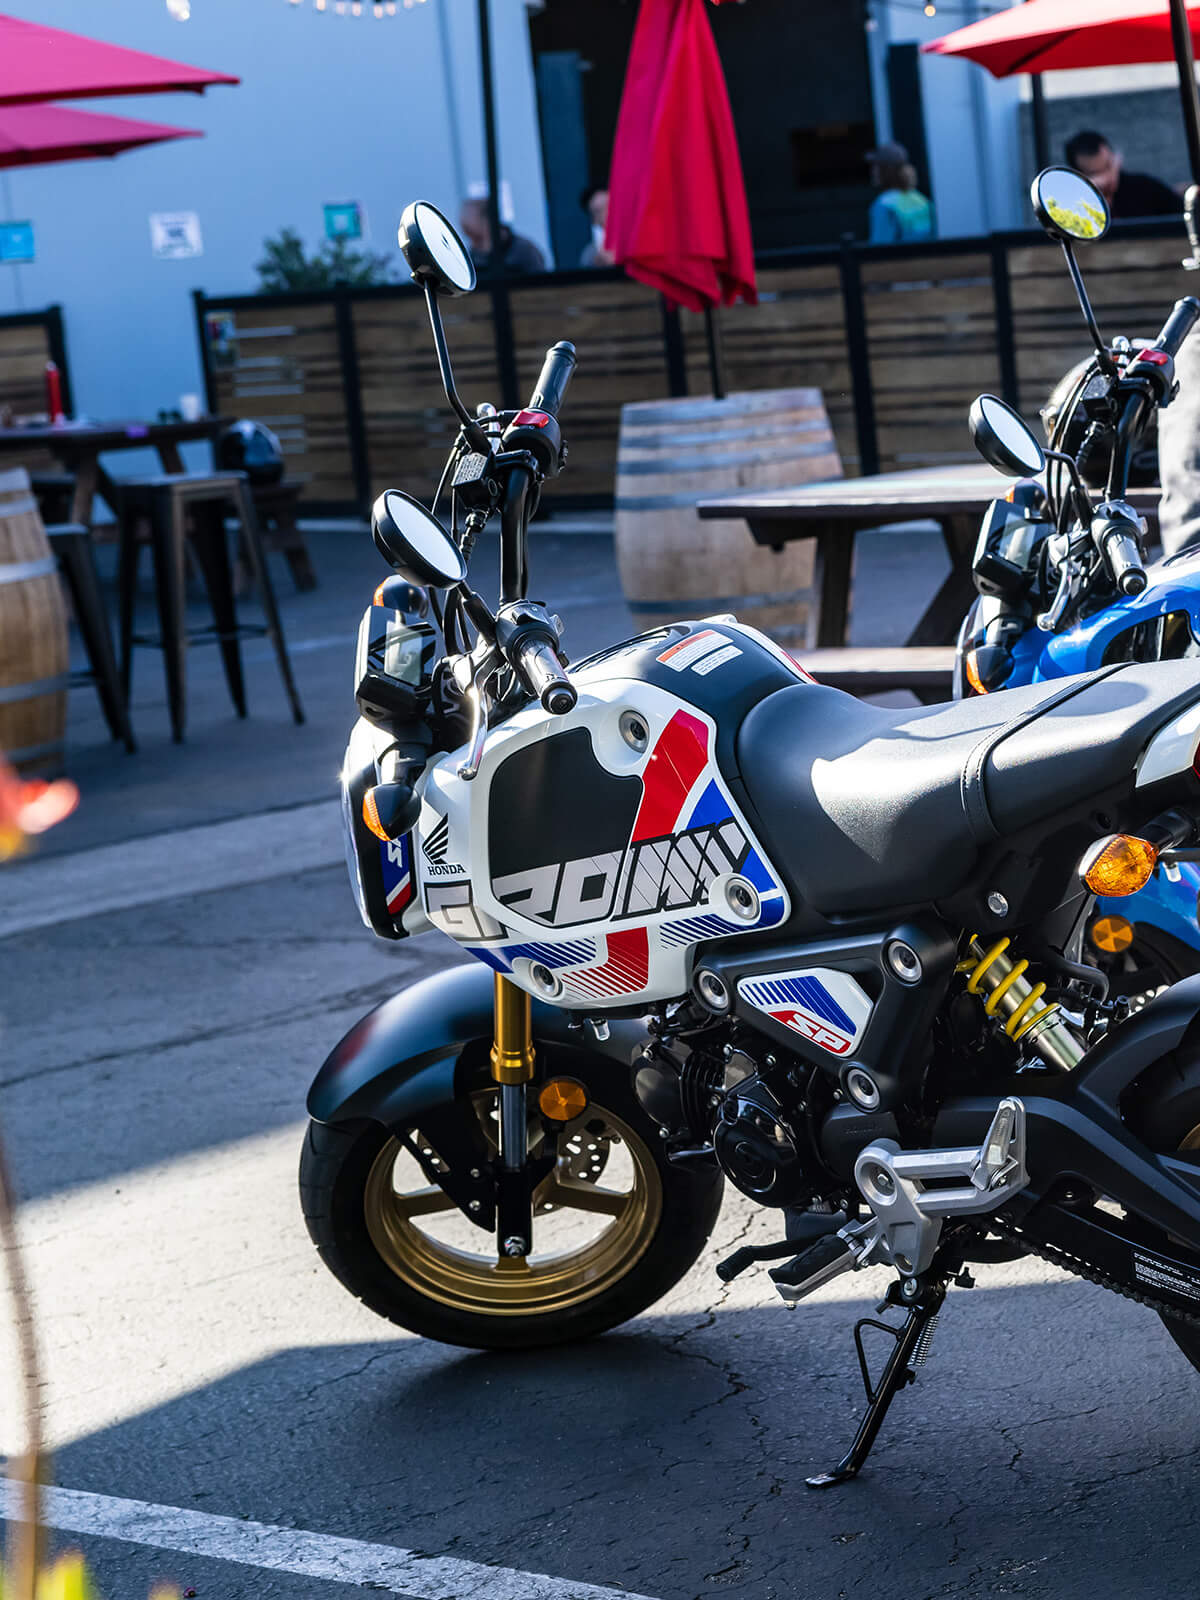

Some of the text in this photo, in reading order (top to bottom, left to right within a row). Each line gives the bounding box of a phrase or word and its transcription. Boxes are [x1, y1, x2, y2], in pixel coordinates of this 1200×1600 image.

[423, 816, 750, 942] GROM
[427, 864, 467, 876] HONDA
[786, 1013, 847, 1051] SP
